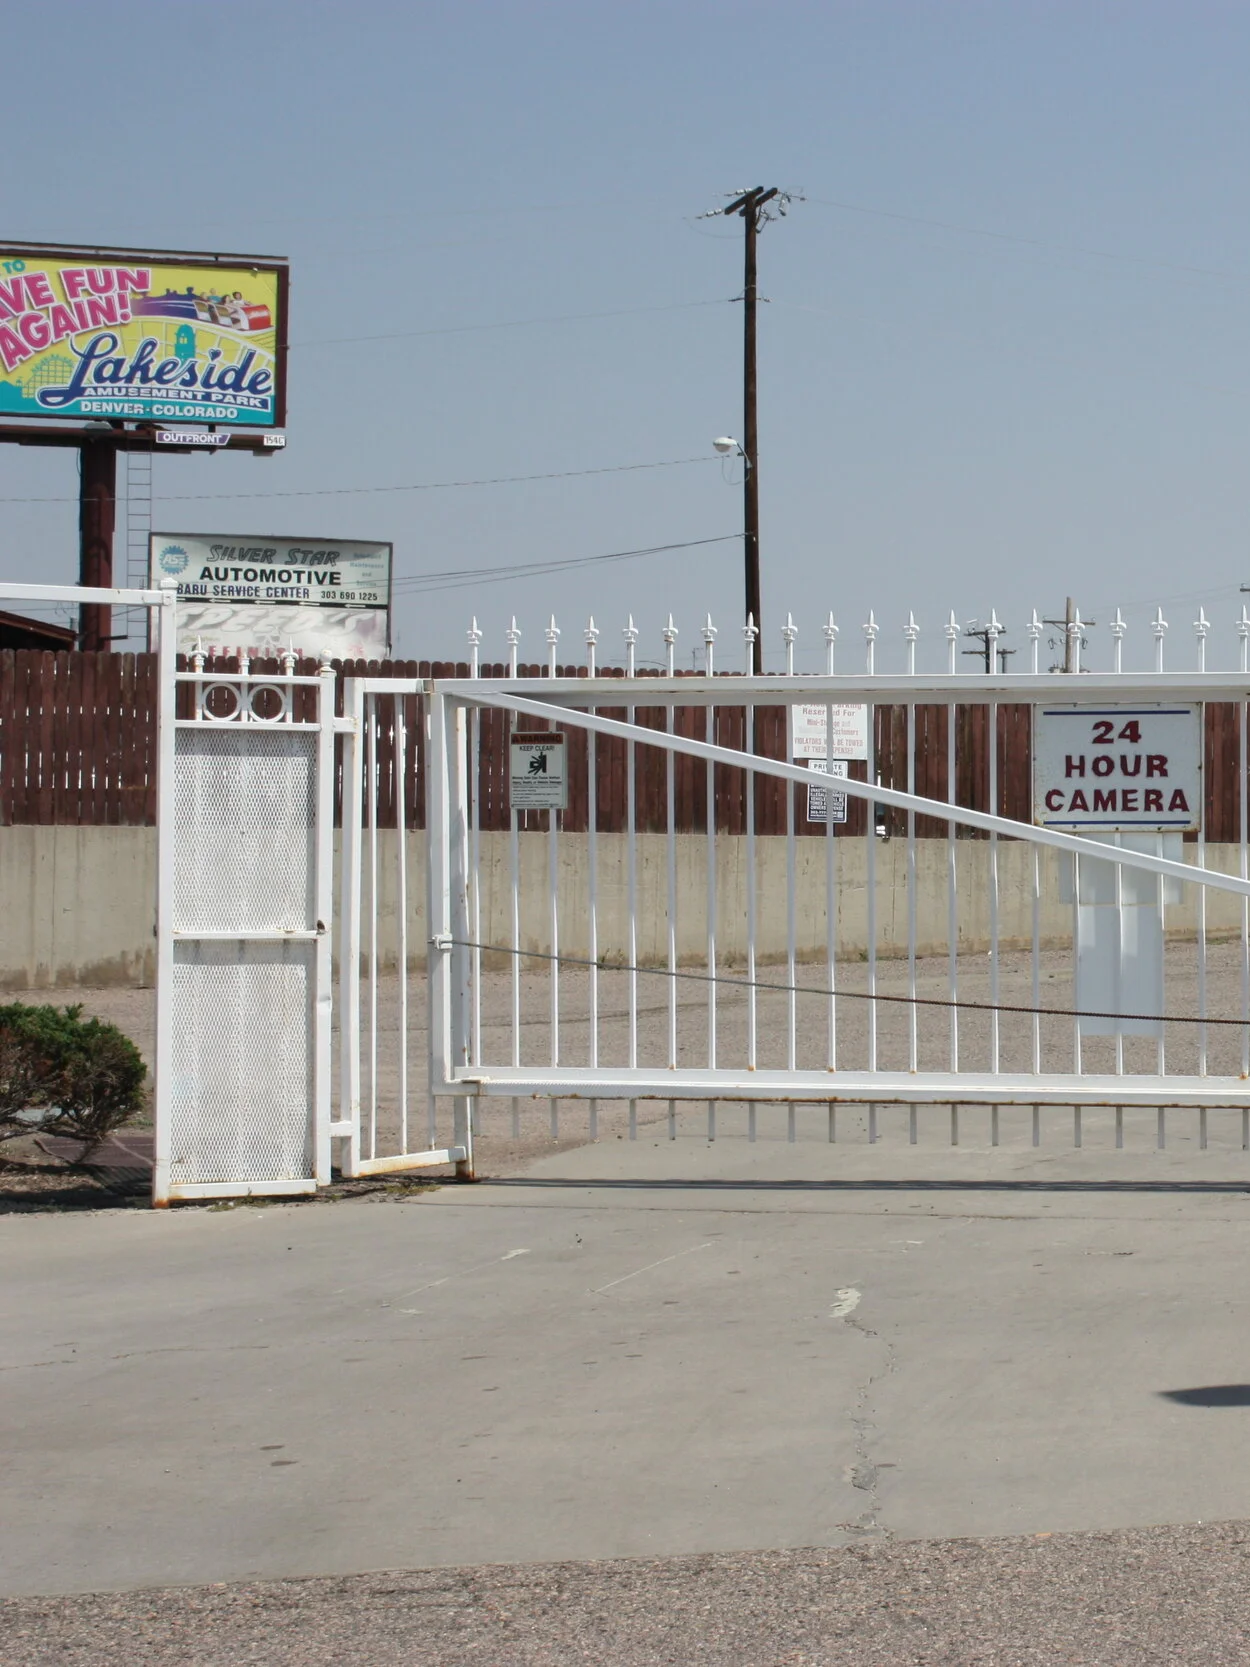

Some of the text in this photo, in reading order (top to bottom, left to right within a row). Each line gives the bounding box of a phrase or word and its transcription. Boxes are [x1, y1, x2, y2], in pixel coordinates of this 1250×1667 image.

[2, 259, 26, 274] TO
[60, 267, 151, 301] FUN
[0, 291, 132, 373] AGAIN!
[36, 331, 274, 408] Lakeside
[83, 387, 263, 409] AMUSEMENT PARK
[81, 401, 239, 419] DENVER COLORADO
[163, 433, 223, 443] OUTFRONT
[206, 544, 341, 567] SILVER STAR
[200, 566, 342, 586] AUTOMOTIVE
[176, 583, 208, 596] BARU
[212, 584, 261, 598] SERVICE
[265, 587, 310, 600] CENTER
[320, 590, 337, 600] 303
[358, 591, 379, 602] 1225
[802, 707, 840, 716] Resered
[1091, 720, 1142, 744] 24
[1065, 754, 1169, 778] HOUR
[1044, 788, 1190, 813] CAMERA
